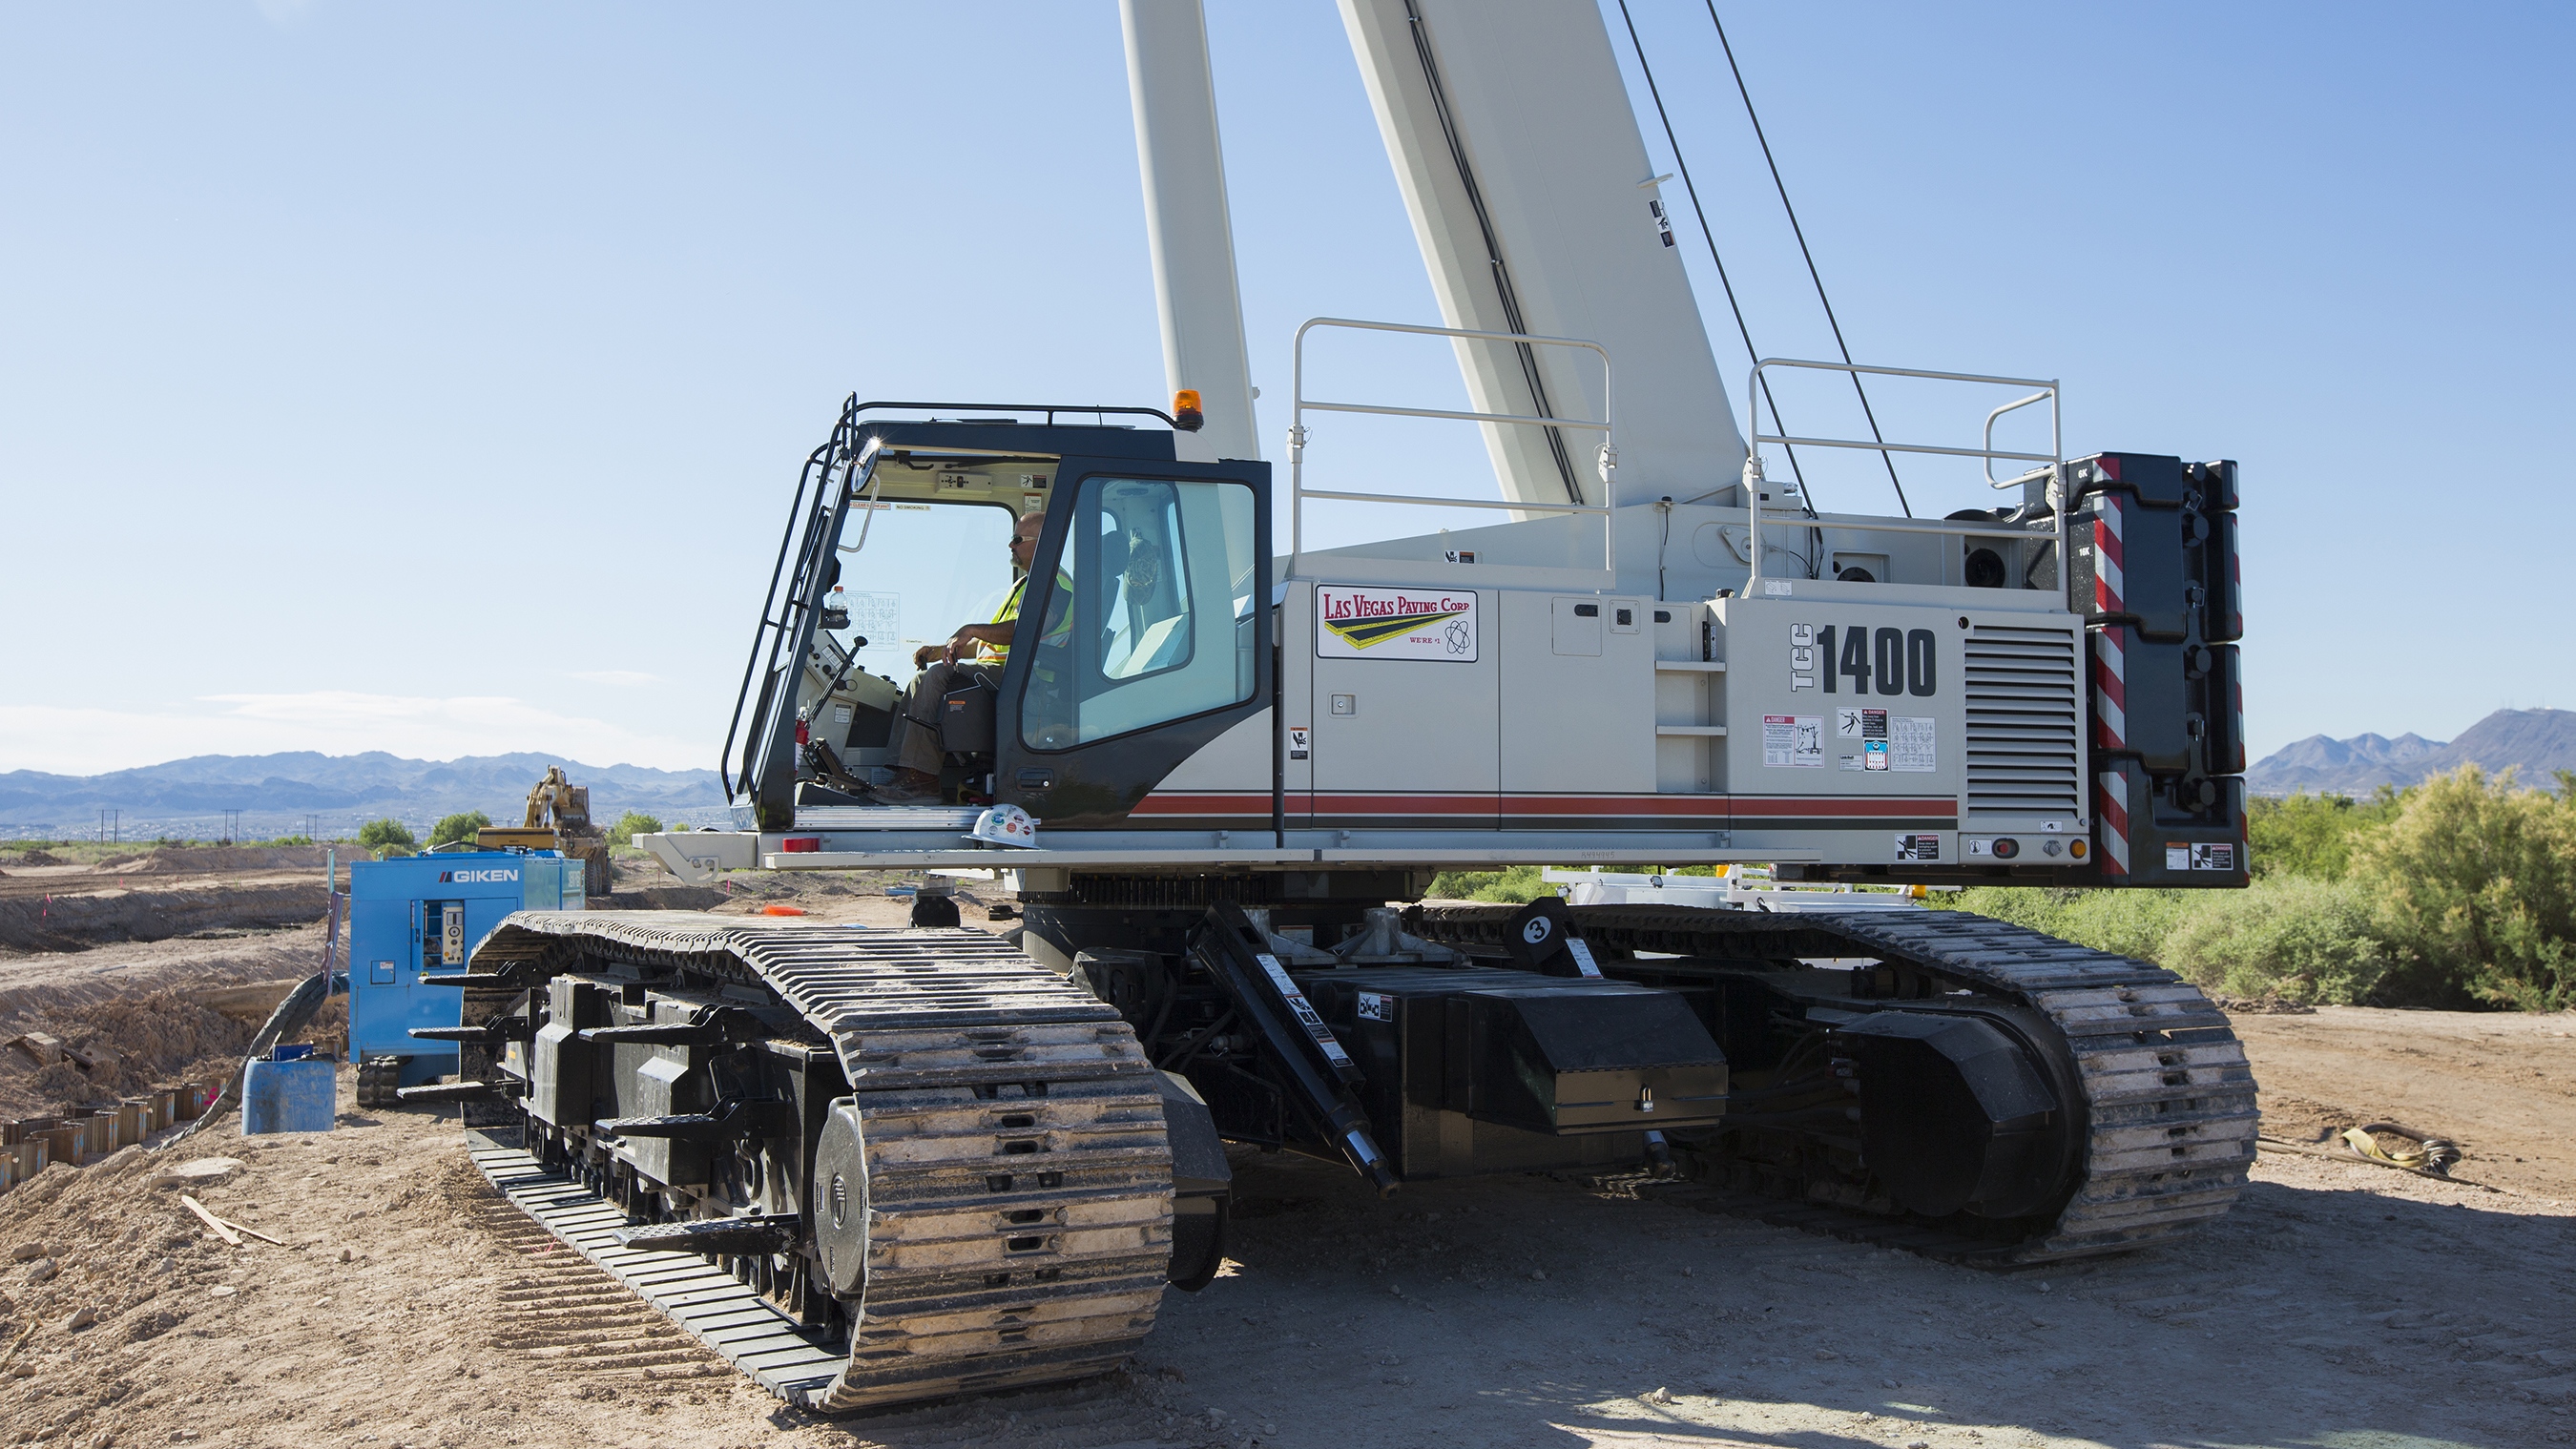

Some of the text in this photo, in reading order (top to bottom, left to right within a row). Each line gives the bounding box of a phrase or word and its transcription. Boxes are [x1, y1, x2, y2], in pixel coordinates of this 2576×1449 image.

[1790, 623, 1814, 693] TCC
[1817, 624, 1936, 697] 1400
[453, 869, 519, 883] GIKEN
[1529, 920, 1546, 940] 3
